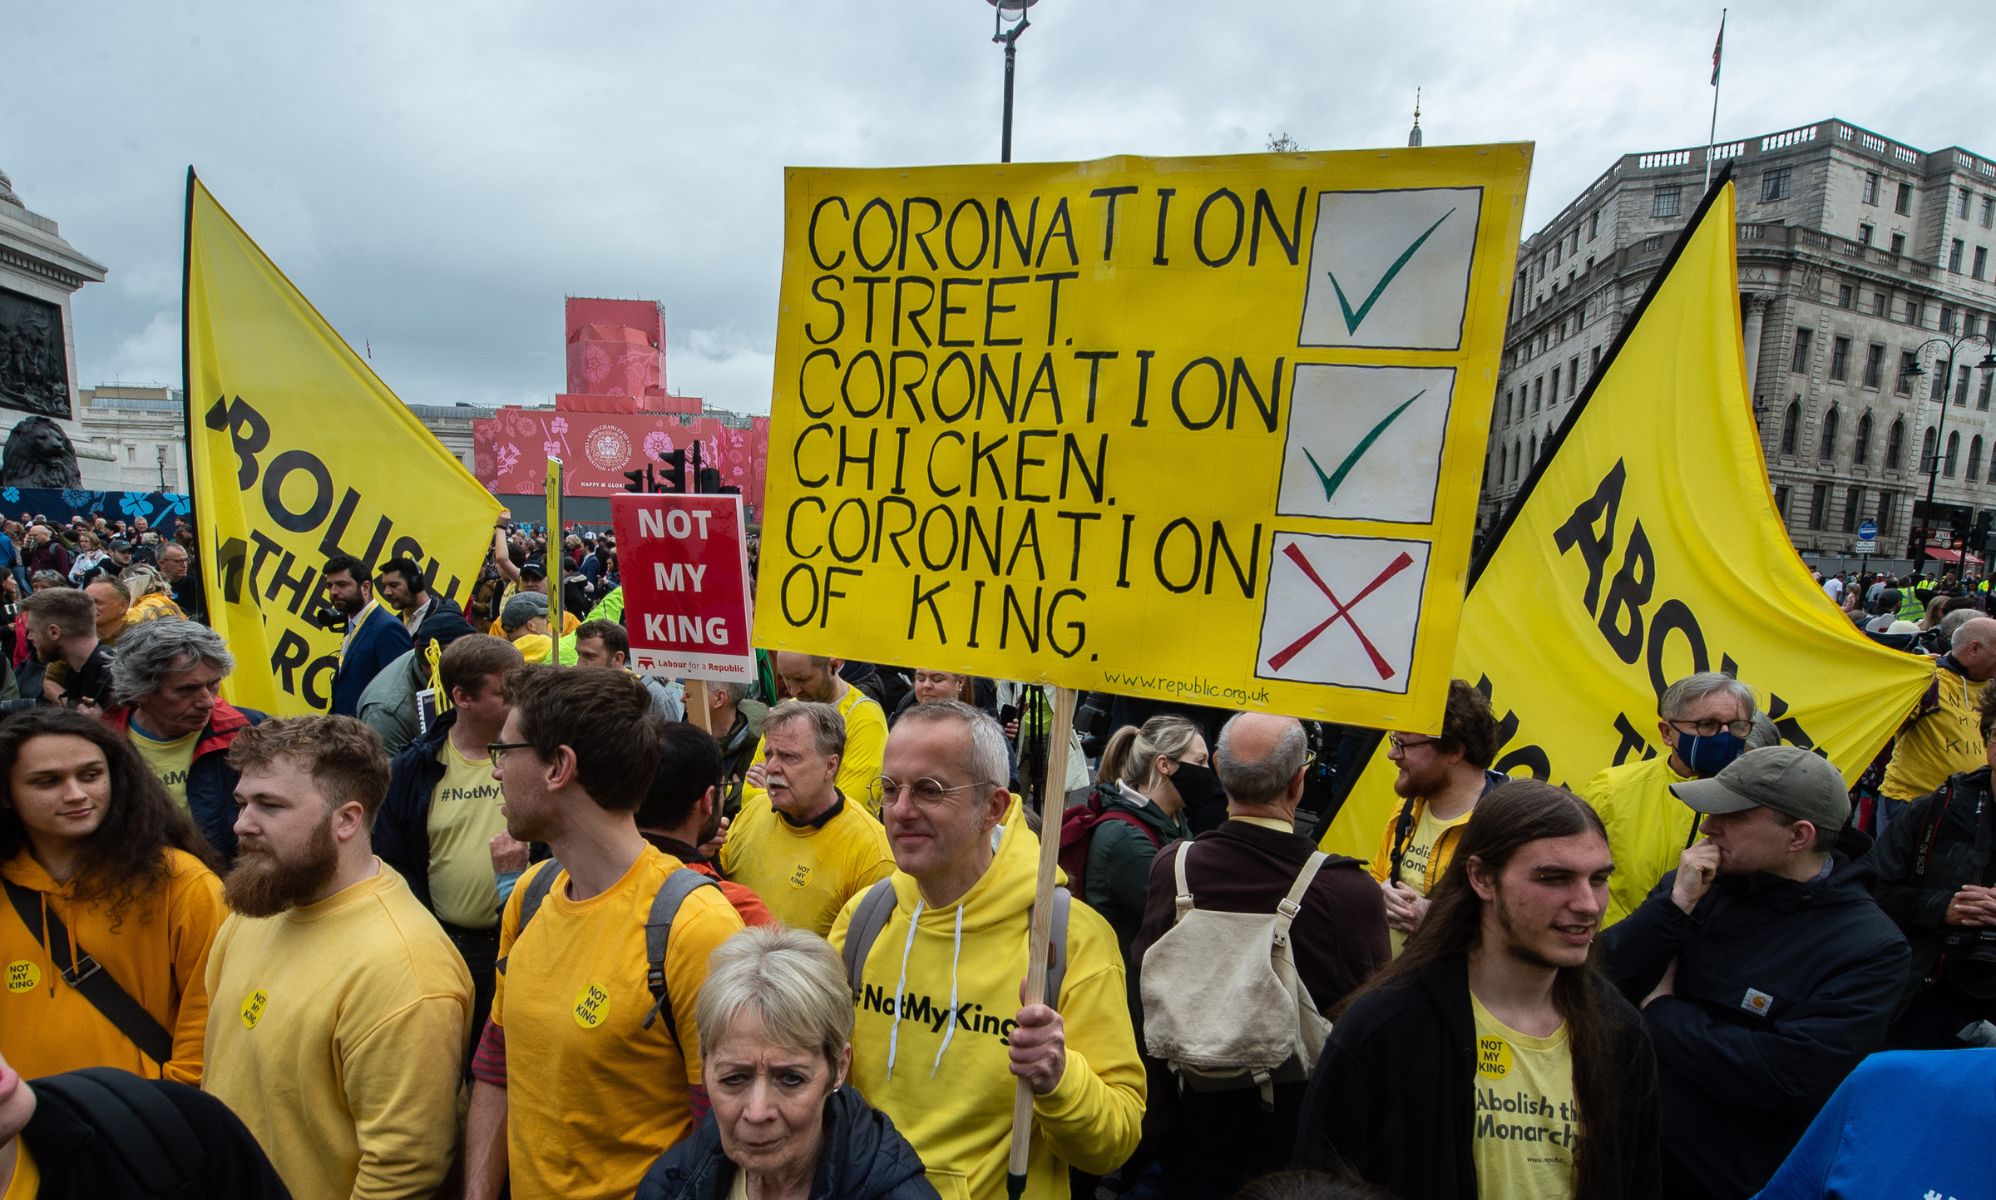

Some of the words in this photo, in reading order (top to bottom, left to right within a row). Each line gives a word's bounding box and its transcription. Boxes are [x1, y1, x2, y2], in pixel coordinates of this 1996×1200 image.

[808, 185, 1308, 272] CORONATION
[805, 271, 1079, 346] STREET.
[799, 349, 1284, 433] CORONATION
[793, 422, 1116, 505] CHICKEN.
[638, 508, 712, 539] NOT
[786, 496, 1262, 599] CORONATION
[654, 562, 707, 592] MY
[781, 566, 863, 629] OF
[908, 574, 1100, 663] KING.
[644, 613, 729, 645] KING
[658, 660, 686, 668] Labour
[688, 662, 700, 670] for
[708, 664, 744, 672] Republic
[1104, 671, 1270, 706] www.republic.org.uk
[1959, 716, 1979, 728] MY
[1945, 737, 1982, 755] KIN
[797, 864, 810, 874] NOT
[791, 876, 805, 886] KING
[10, 964, 30, 972] NOT
[9, 980, 34, 989] KING
[588, 985, 608, 1004] NOT
[576, 1004, 597, 1024] KING
[584, 997, 600, 1012] MY
[1481, 1040, 1503, 1052] NOT
[1484, 1052, 1500, 1062] MY
[1479, 1062, 1505, 1074] KING
[1476, 1088, 1554, 1118] Abolish
[1559, 1099, 1578, 1122] th
[1477, 1114, 1574, 1149] Monarch
